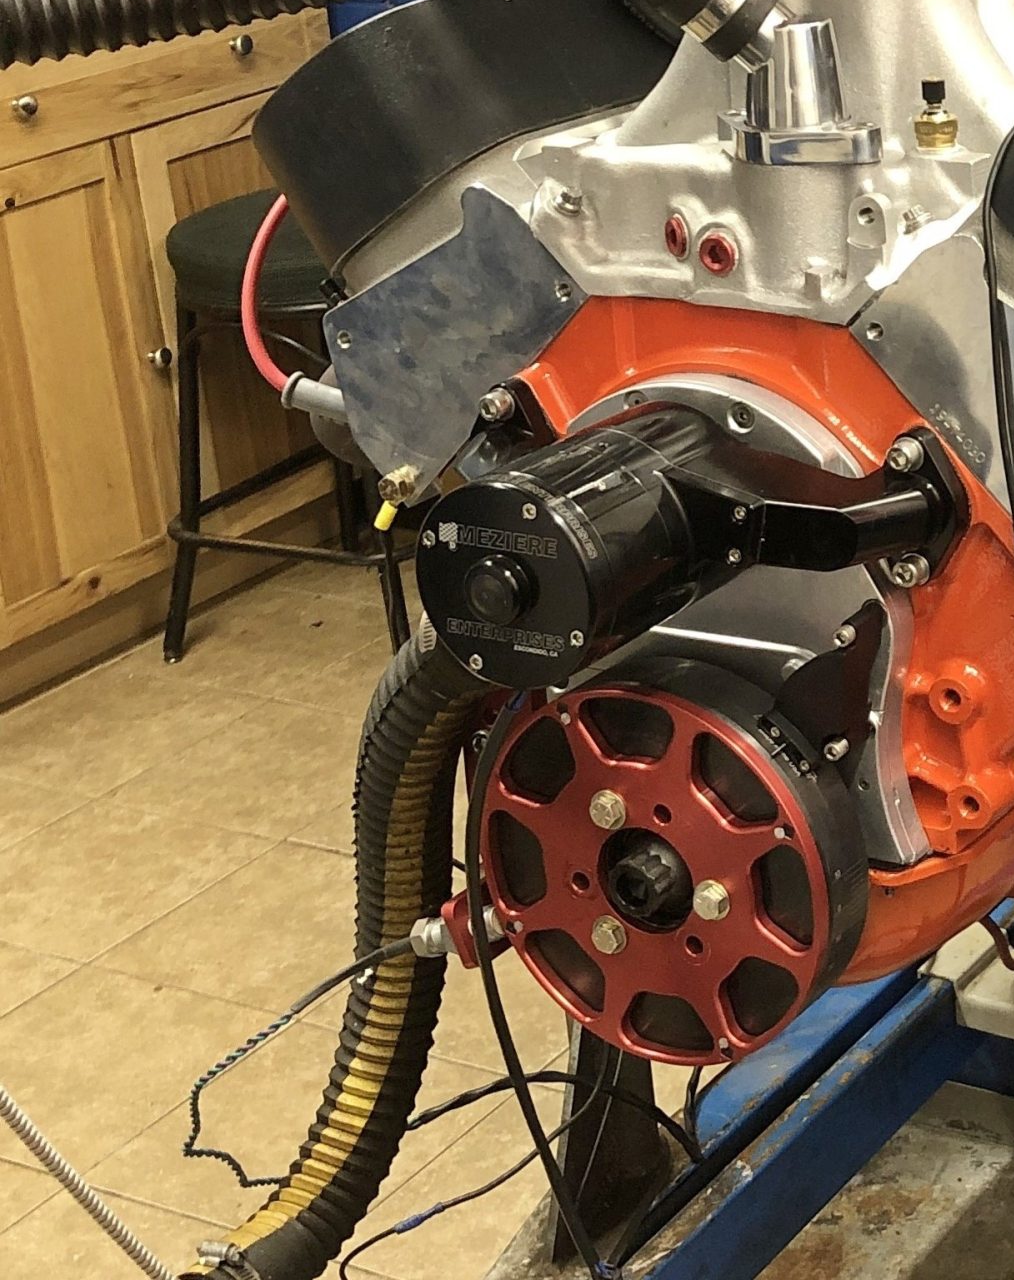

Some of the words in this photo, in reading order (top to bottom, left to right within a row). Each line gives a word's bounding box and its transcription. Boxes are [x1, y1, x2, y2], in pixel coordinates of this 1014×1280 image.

[456, 523, 559, 560] MEZIERE
[446, 617, 566, 653] ENTERPRISES
[549, 650, 559, 658] CA
